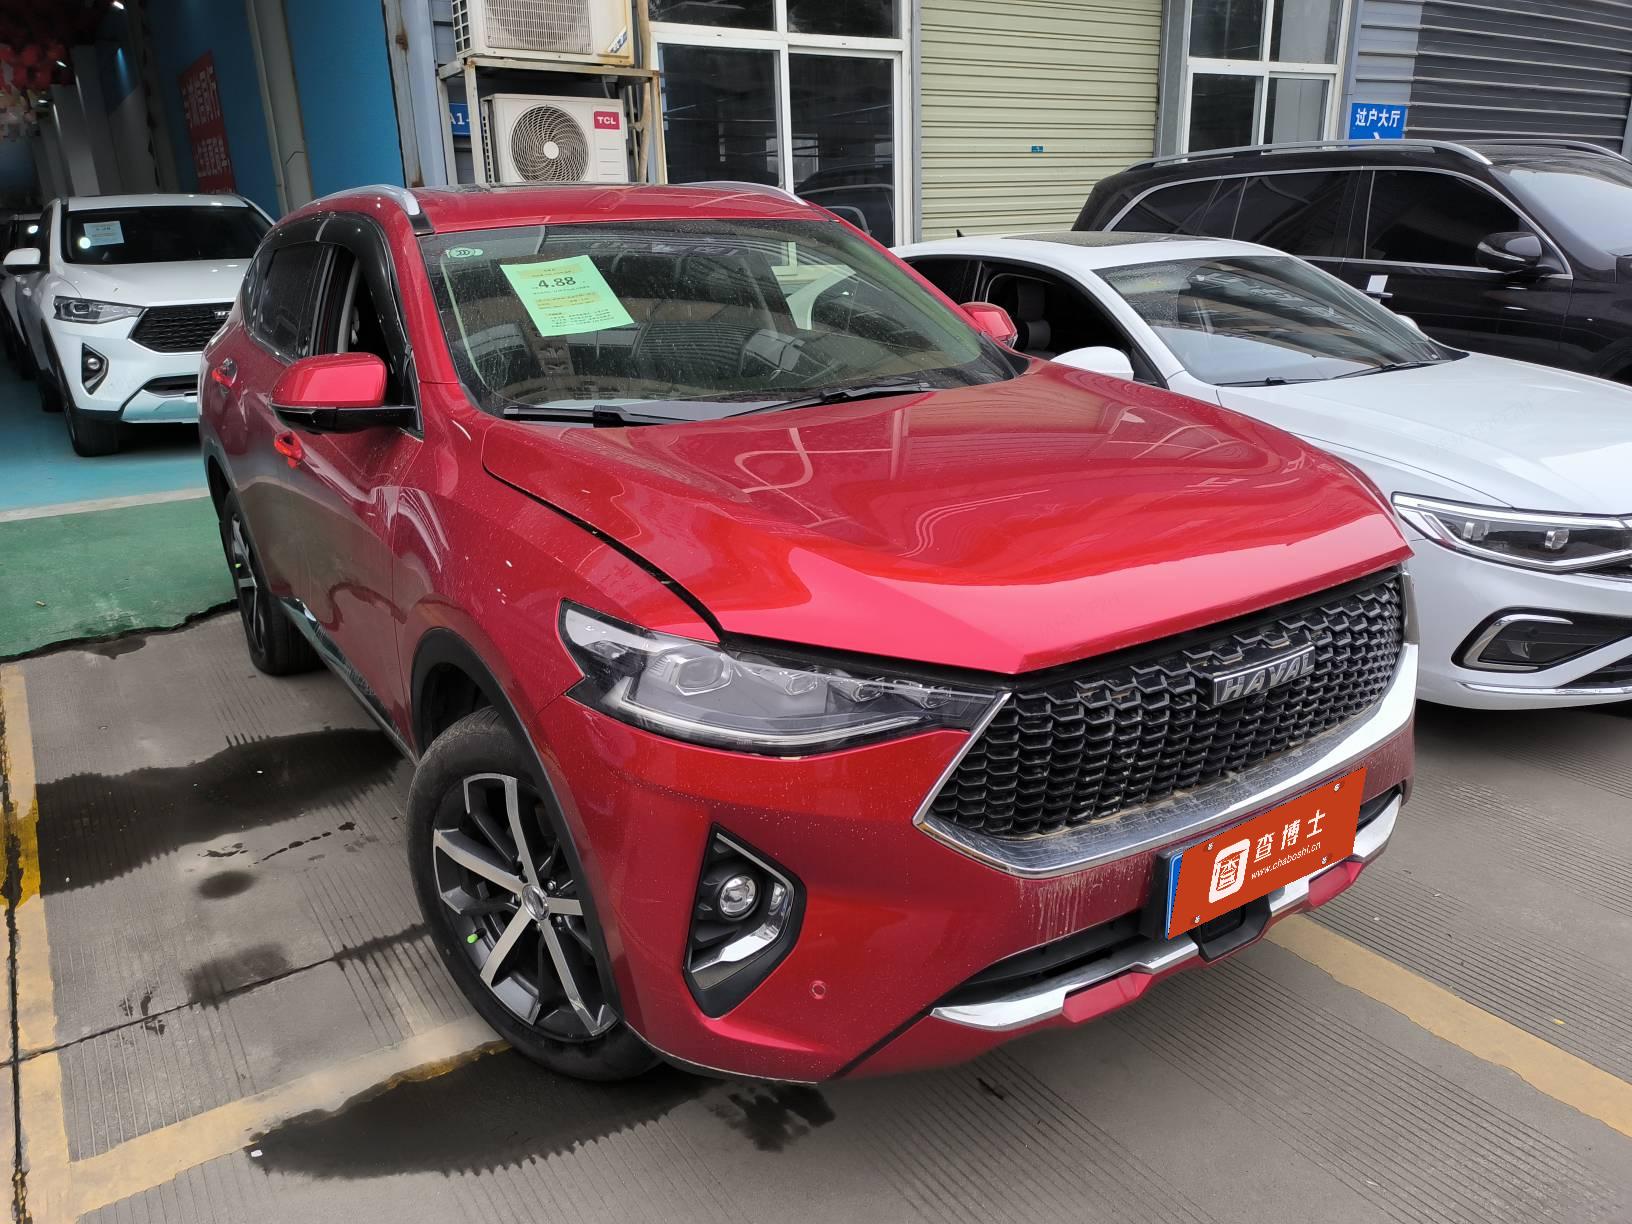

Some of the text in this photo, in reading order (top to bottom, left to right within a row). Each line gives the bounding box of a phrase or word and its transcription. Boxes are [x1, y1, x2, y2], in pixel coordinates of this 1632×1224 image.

[597, 116, 617, 125] TCL
[1355, 107, 1401, 128] 过户大厅
[538, 276, 577, 289] 4.88
[1220, 653, 1315, 702] HAVAL
